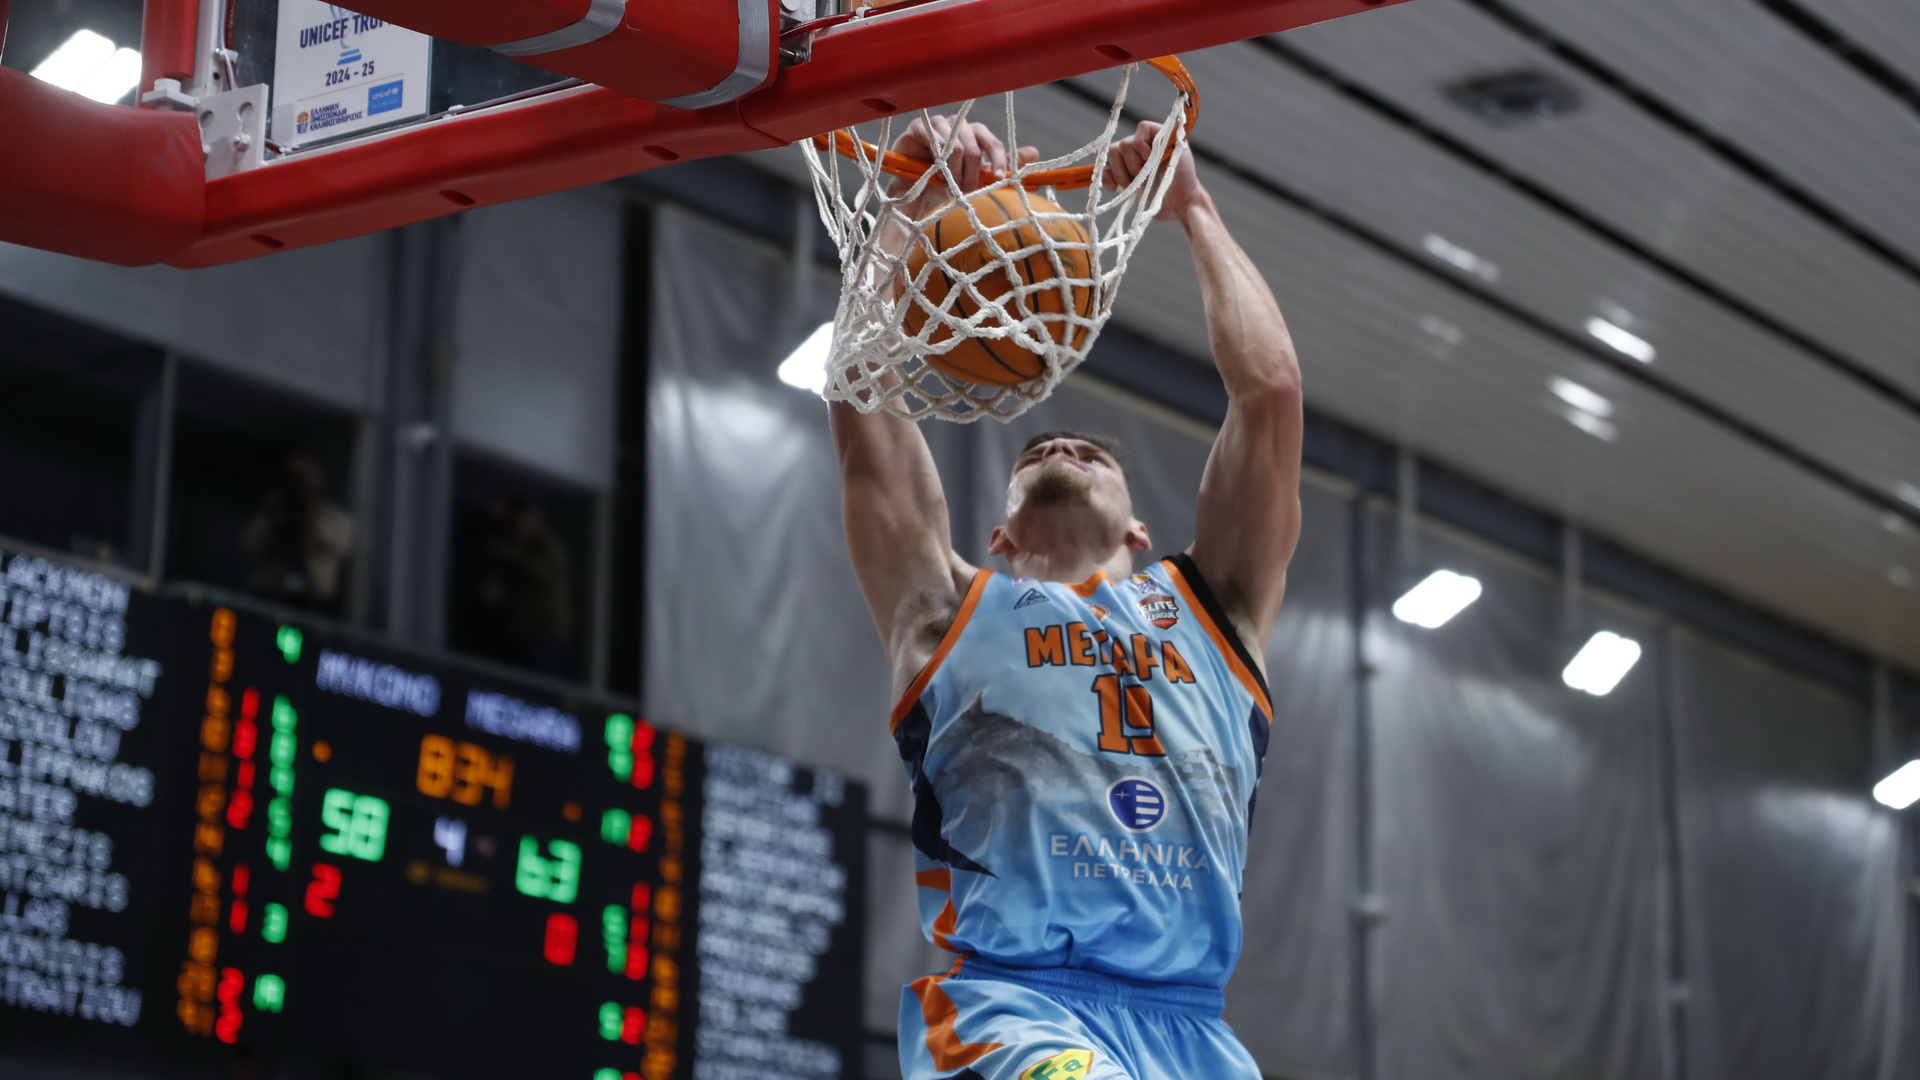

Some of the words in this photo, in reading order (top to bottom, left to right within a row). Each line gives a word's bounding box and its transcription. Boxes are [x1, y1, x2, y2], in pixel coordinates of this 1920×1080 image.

[300, 18, 349, 48] UNICEF
[353, 14, 391, 34] TRO
[325, 68, 351, 87] 2024
[362, 61, 375, 77] 25
[310, 102, 340, 115] ΕΛΛΗΝΙΚΗ
[1141, 600, 1178, 613] ELITE
[1147, 611, 1177, 621] LEAGUE
[320, 788, 391, 862] 58
[433, 816, 468, 867] 4
[515, 835, 582, 904] 63
[1051, 834, 1211, 874] ΕΛΛΗΝΙΚΑ
[304, 862, 343, 918] 2
[1074, 862, 1194, 890] ΠΕΤΡΕΛΑΙΑ
